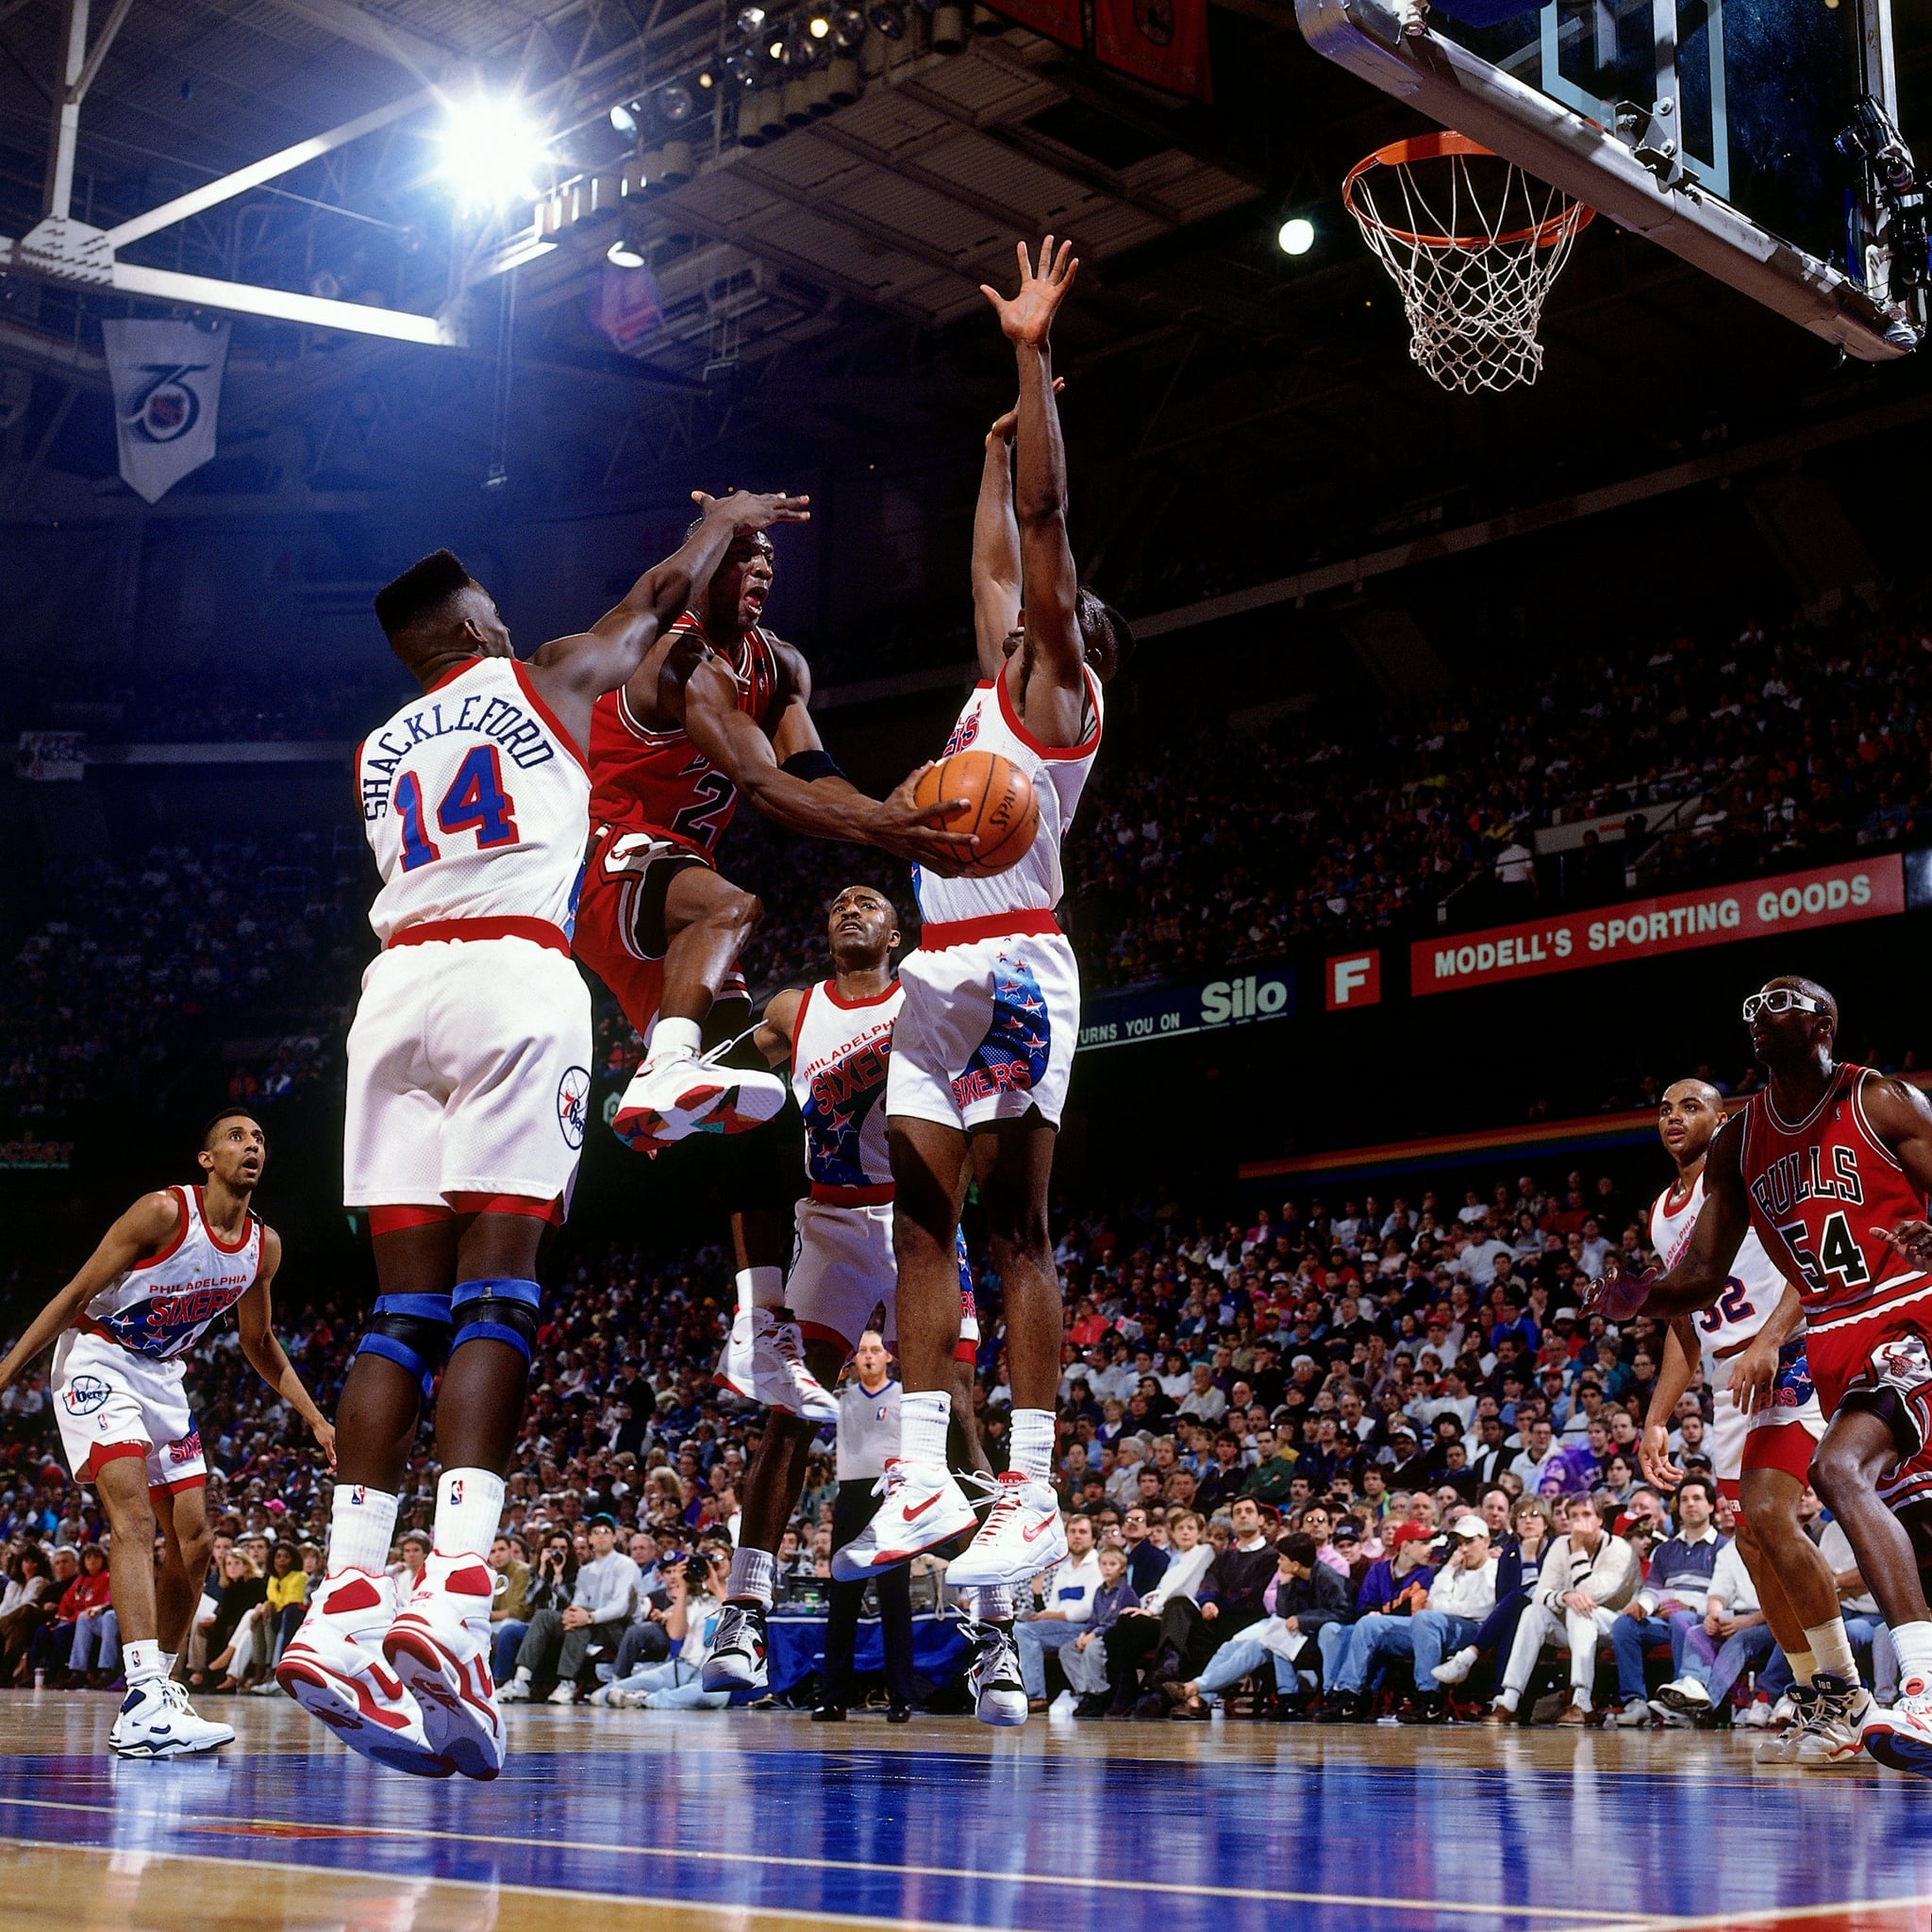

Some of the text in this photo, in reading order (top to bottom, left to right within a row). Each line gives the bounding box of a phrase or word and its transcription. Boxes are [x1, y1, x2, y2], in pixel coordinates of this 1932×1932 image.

[363, 695, 555, 821] SHACKLEFORD
[393, 743, 520, 874] 14
[1435, 874, 1872, 978] MODELL'S SPORTING GOODS
[1200, 975, 1288, 1024] Silo
[1335, 957, 1371, 1005] F
[1125, 1017, 1154, 1037] YOU
[1160, 1012, 1180, 1031] ON
[951, 1059, 1032, 1110] SIXERS
[0, 1131, 74, 1161] cker
[1750, 1145, 1864, 1230] BULLS
[1777, 1210, 1871, 1293] 54
[149, 1274, 247, 1293] PHILADELPHIA
